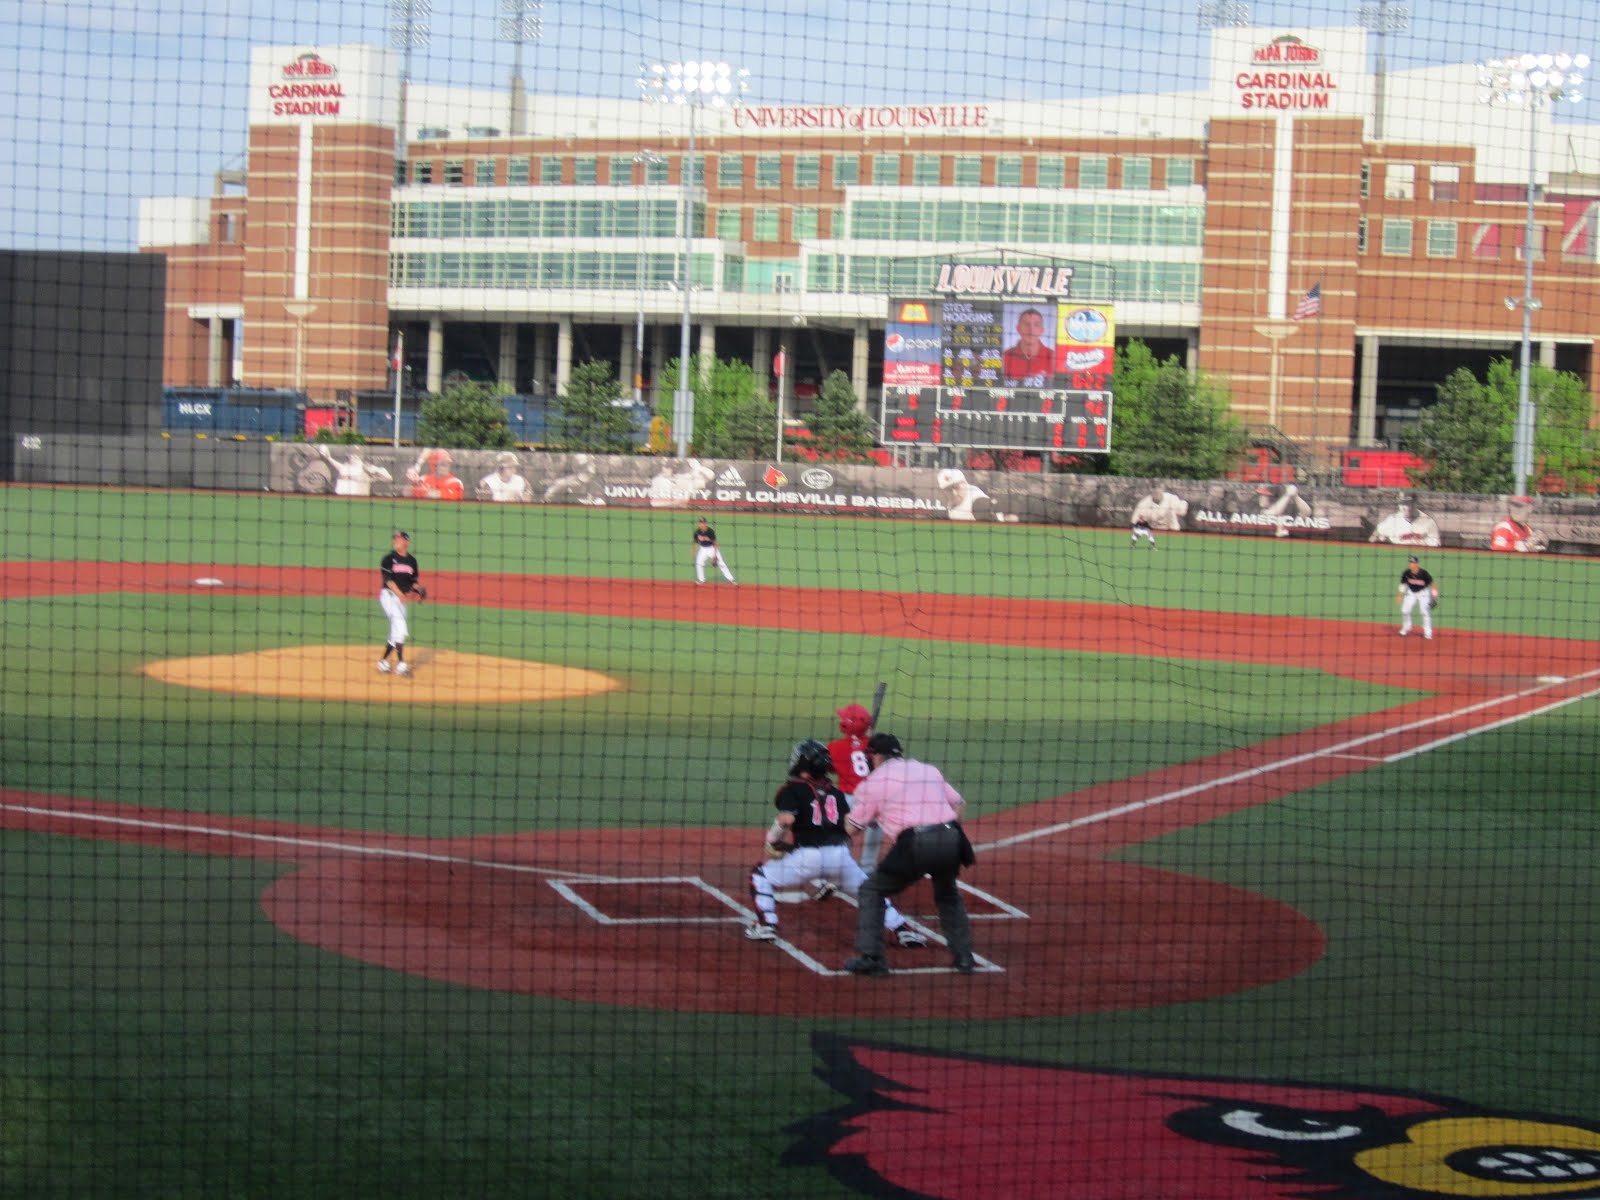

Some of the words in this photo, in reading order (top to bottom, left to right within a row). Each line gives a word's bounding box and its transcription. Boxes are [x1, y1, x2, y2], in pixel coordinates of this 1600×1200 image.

[1236, 73, 1337, 89] CARDINAL
[268, 84, 346, 99] CARDINAL
[273, 101, 340, 116] STADIUM
[1241, 93, 1329, 110] STADIUM
[733, 107, 849, 129] UNIVERSITY
[868, 106, 989, 128] LOUISVILLE
[935, 264, 1073, 296] LOUISVILLE
[716, 489, 742, 502] OF
[745, 490, 848, 507] LOUISVILLE
[851, 494, 947, 511] BASEBALL
[1195, 510, 1227, 523] ALL
[1229, 512, 1332, 530] AMERICANS
